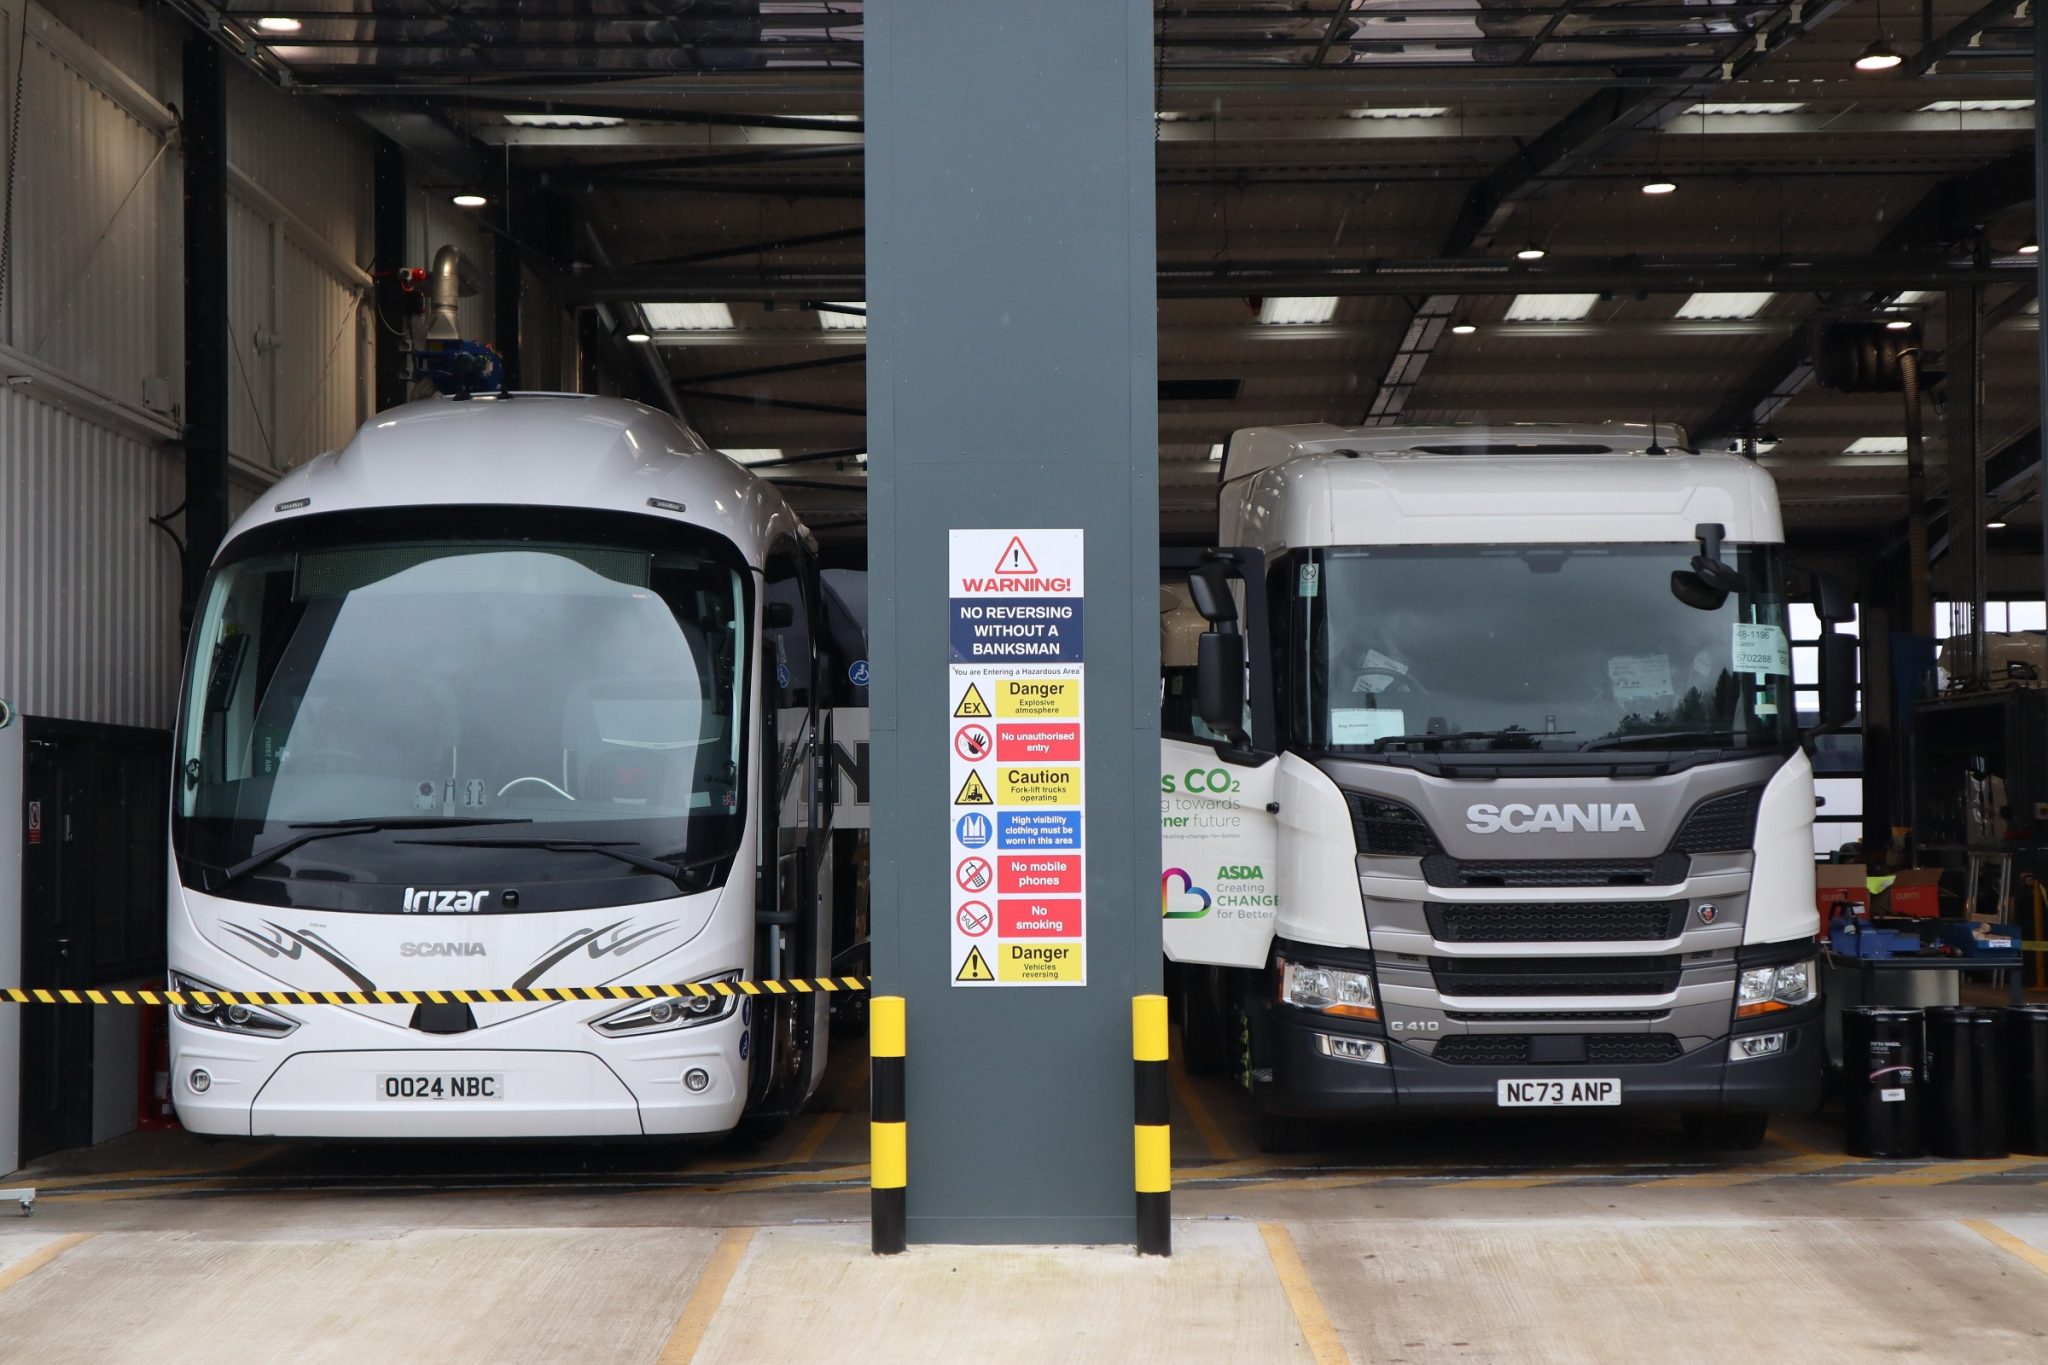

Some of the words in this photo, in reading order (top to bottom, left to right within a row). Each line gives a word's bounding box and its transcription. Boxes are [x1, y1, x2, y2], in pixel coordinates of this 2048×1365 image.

[962, 578, 1071, 592] WARNING!
[961, 607, 982, 619] NO
[986, 606, 1072, 619] REVERSING
[974, 625, 1044, 637] WITHOUT
[1048, 625, 1058, 637] A
[973, 643, 1060, 655] BANKSMAN
[984, 668, 1014, 677] Entering
[1022, 667, 1061, 675] Hazardous
[1063, 667, 1080, 675] Area
[1010, 682, 1064, 697] Danger
[964, 703, 980, 714] EX
[1019, 699, 1055, 708] Explosive
[1015, 706, 1059, 715] atmosphere
[1017, 732, 1074, 740] unauthorised
[1027, 745, 1050, 753] entry
[1008, 770, 1069, 784] Caution
[1011, 786, 1041, 794] Fork-lift
[1176, 797, 1240, 810] towards
[1012, 816, 1030, 825] High
[1033, 816, 1066, 825] visibility
[1161, 816, 1189, 827] ner
[1193, 814, 1240, 828] future
[1466, 803, 1646, 834] SCANIA
[1005, 826, 1038, 835] clothing
[1062, 826, 1073, 834] be
[1011, 862, 1027, 871] No
[1030, 862, 1067, 871] mobile
[1217, 866, 1263, 880] ASDA
[1019, 876, 1059, 887] phones
[1217, 884, 1264, 894] Creating
[403, 887, 489, 912] Irizar
[1032, 906, 1047, 915] No
[1217, 910, 1233, 919] for
[1238, 910, 1273, 919] Better
[1016, 920, 1063, 931] smoking
[400, 942, 487, 957] SCANIA
[1012, 946, 1069, 962] Danger
[451, 1077, 495, 1097] NBC
[1507, 1083, 1564, 1102] NC73
[1571, 1083, 1612, 1102] ANP
